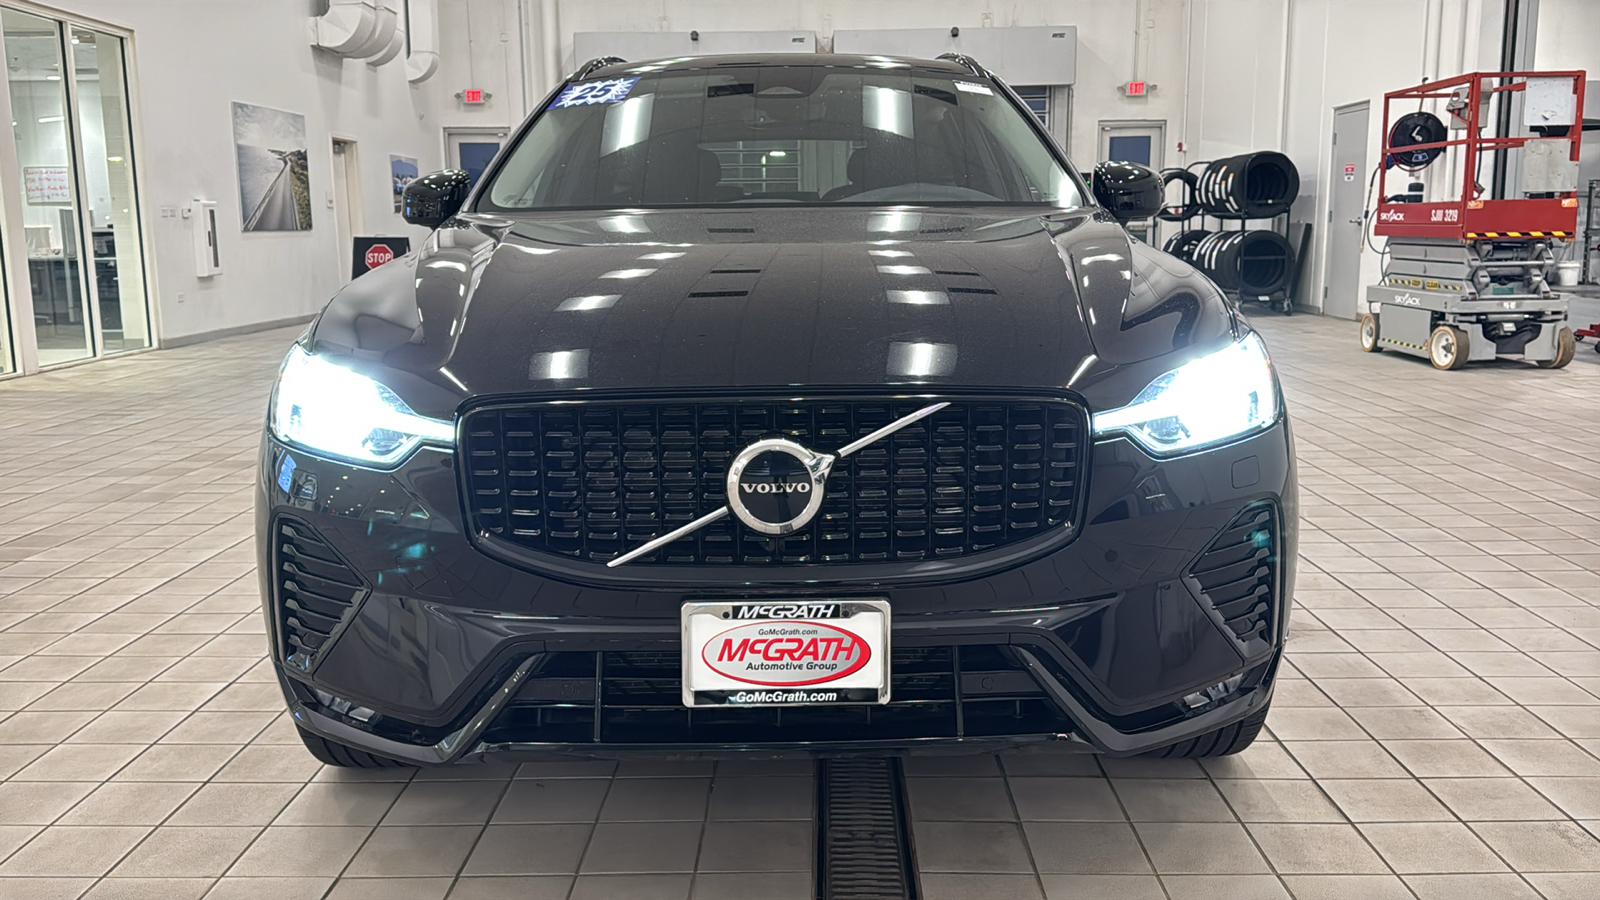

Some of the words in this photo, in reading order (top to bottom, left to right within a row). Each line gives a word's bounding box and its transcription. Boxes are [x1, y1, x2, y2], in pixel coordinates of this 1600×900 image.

[569, 83, 617, 101] 25
[1129, 81, 1145, 94] EXIT
[466, 89, 481, 102] EXIT
[1380, 209, 1405, 222] SKYJACK
[1444, 209, 1459, 222] 3219
[367, 252, 391, 264] STOP
[1394, 293, 1421, 306] SKYJACK
[740, 482, 811, 494] VOLVO
[758, 628, 818, 636] GoMcGrath.com
[745, 661, 803, 671] Automotive
[806, 661, 838, 672] Group
[736, 691, 837, 703] GoMcGrath.com
